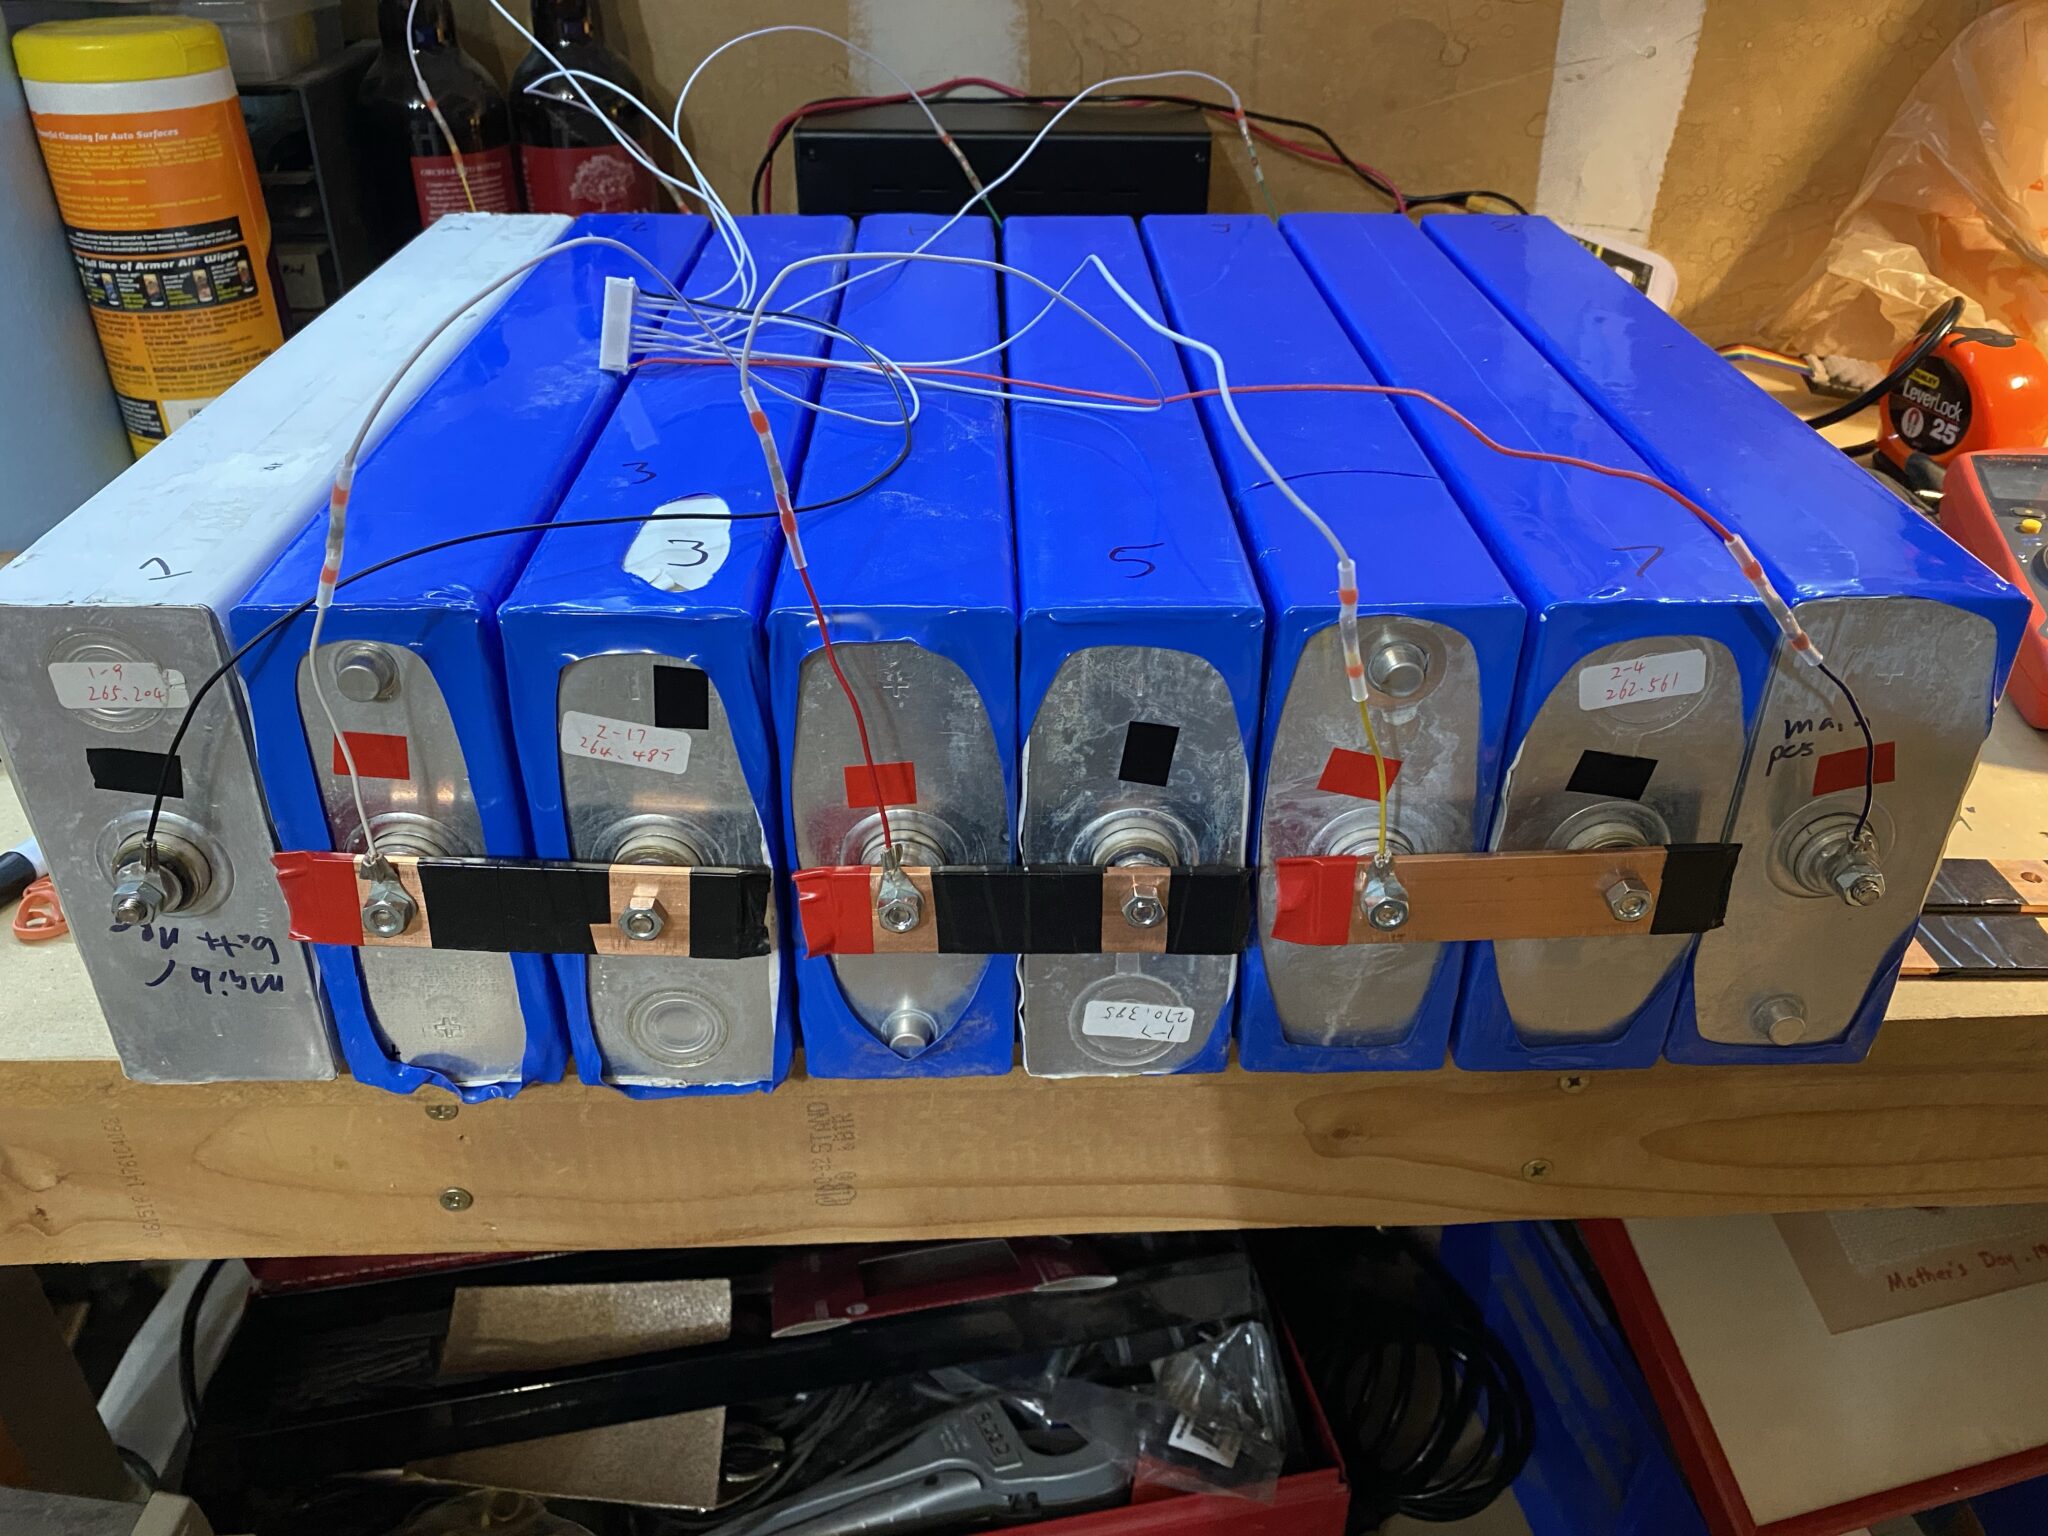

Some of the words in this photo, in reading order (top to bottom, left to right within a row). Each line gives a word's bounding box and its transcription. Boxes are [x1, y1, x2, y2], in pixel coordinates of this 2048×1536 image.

[95, 132, 108, 142] for
[111, 131, 135, 140] Auto
[136, 129, 179, 139] Surfaces
[98, 259, 118, 270] line
[120, 261, 132, 271] of
[135, 260, 175, 270] Armor
[178, 256, 196, 268] All
[204, 250, 239, 264] Wipes
[1902, 379, 1963, 421] LeverLock
[1929, 418, 1960, 445] 25
[622, 462, 657, 485] 3
[666, 539, 709, 567] 3
[1108, 542, 1165, 576] 5
[1610, 544, 1665, 577] 7
[88, 663, 123, 681] 1-9
[1611, 660, 1646, 680] 2-4
[88, 685, 166, 702] 265.204
[1606, 672, 1679, 700] 262.561
[1887, 1261, 1968, 1292] Mother's
